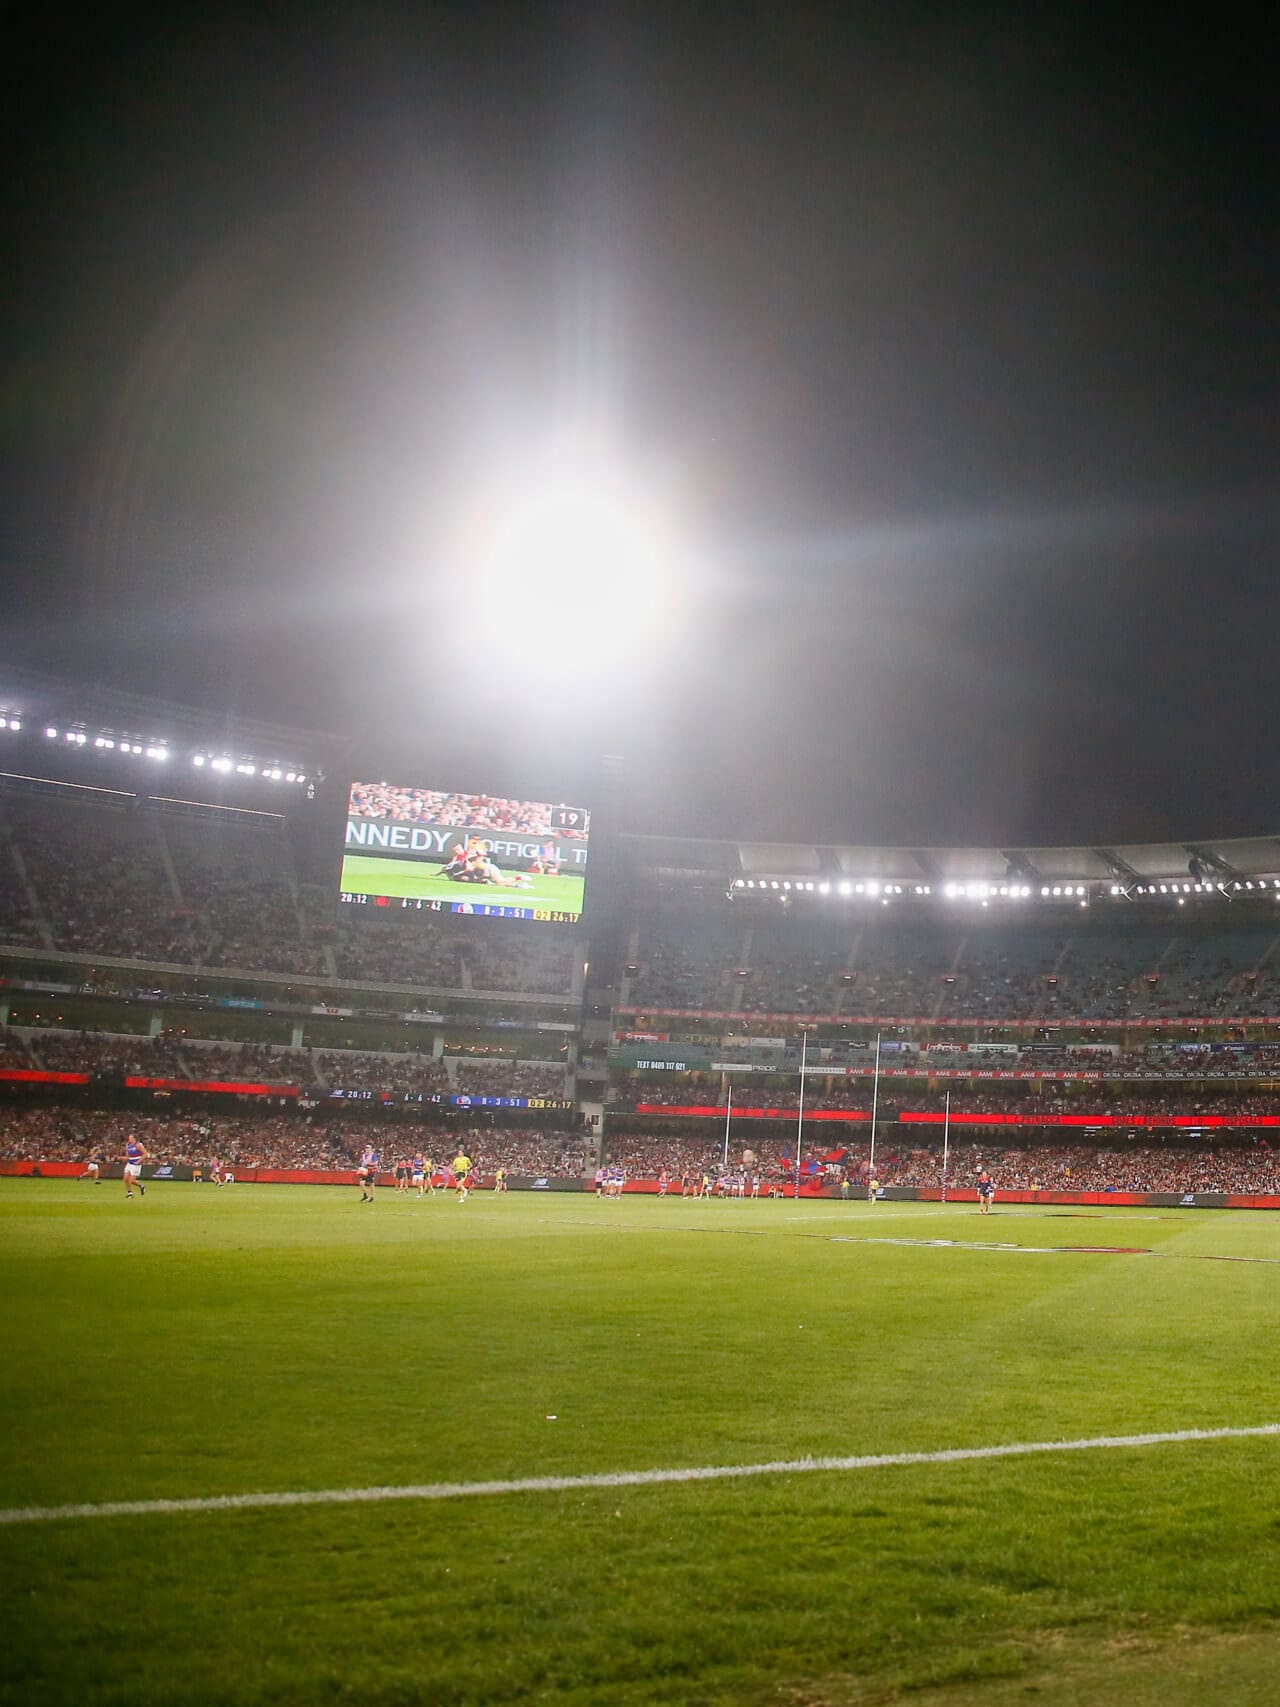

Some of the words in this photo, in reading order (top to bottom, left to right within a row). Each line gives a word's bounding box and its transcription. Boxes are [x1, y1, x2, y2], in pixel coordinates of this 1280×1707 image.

[559, 812, 578, 825] 19
[345, 821, 453, 853] NNEDY
[637, 1061, 649, 1069] TEXT
